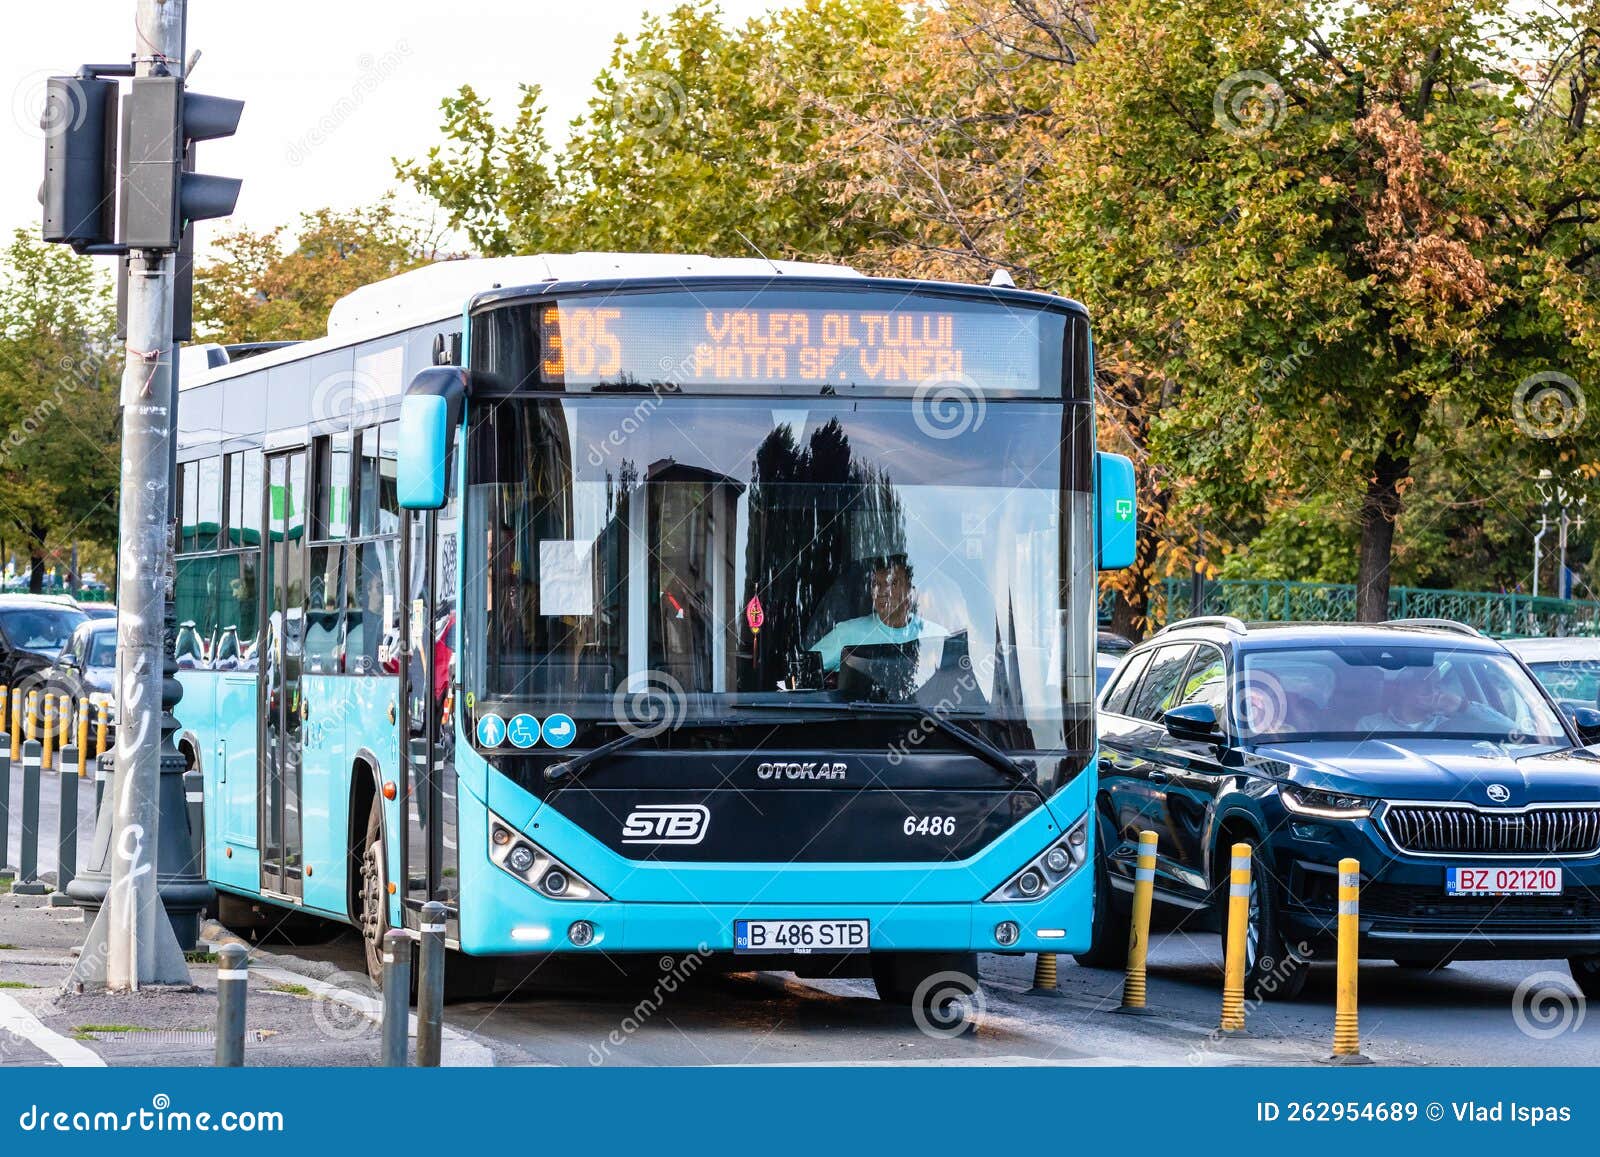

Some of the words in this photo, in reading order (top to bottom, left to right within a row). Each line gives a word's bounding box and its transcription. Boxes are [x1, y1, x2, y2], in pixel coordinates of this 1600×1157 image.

[706, 312, 809, 345] VALEA
[822, 315, 953, 347] OLTULUI
[544, 308, 621, 377] 385
[695, 344, 787, 379] PIATA
[799, 347, 847, 380] SF.
[860, 348, 962, 381] VINERI
[757, 763, 847, 779] OTOKAR
[622, 810, 704, 838] STB
[903, 816, 956, 835] 6486
[1461, 870, 1488, 889] BZ
[1496, 870, 1556, 889] 021210
[737, 937, 747, 946] RO
[751, 925, 766, 946] B
[775, 924, 814, 946] 486
[819, 924, 863, 945] STB
